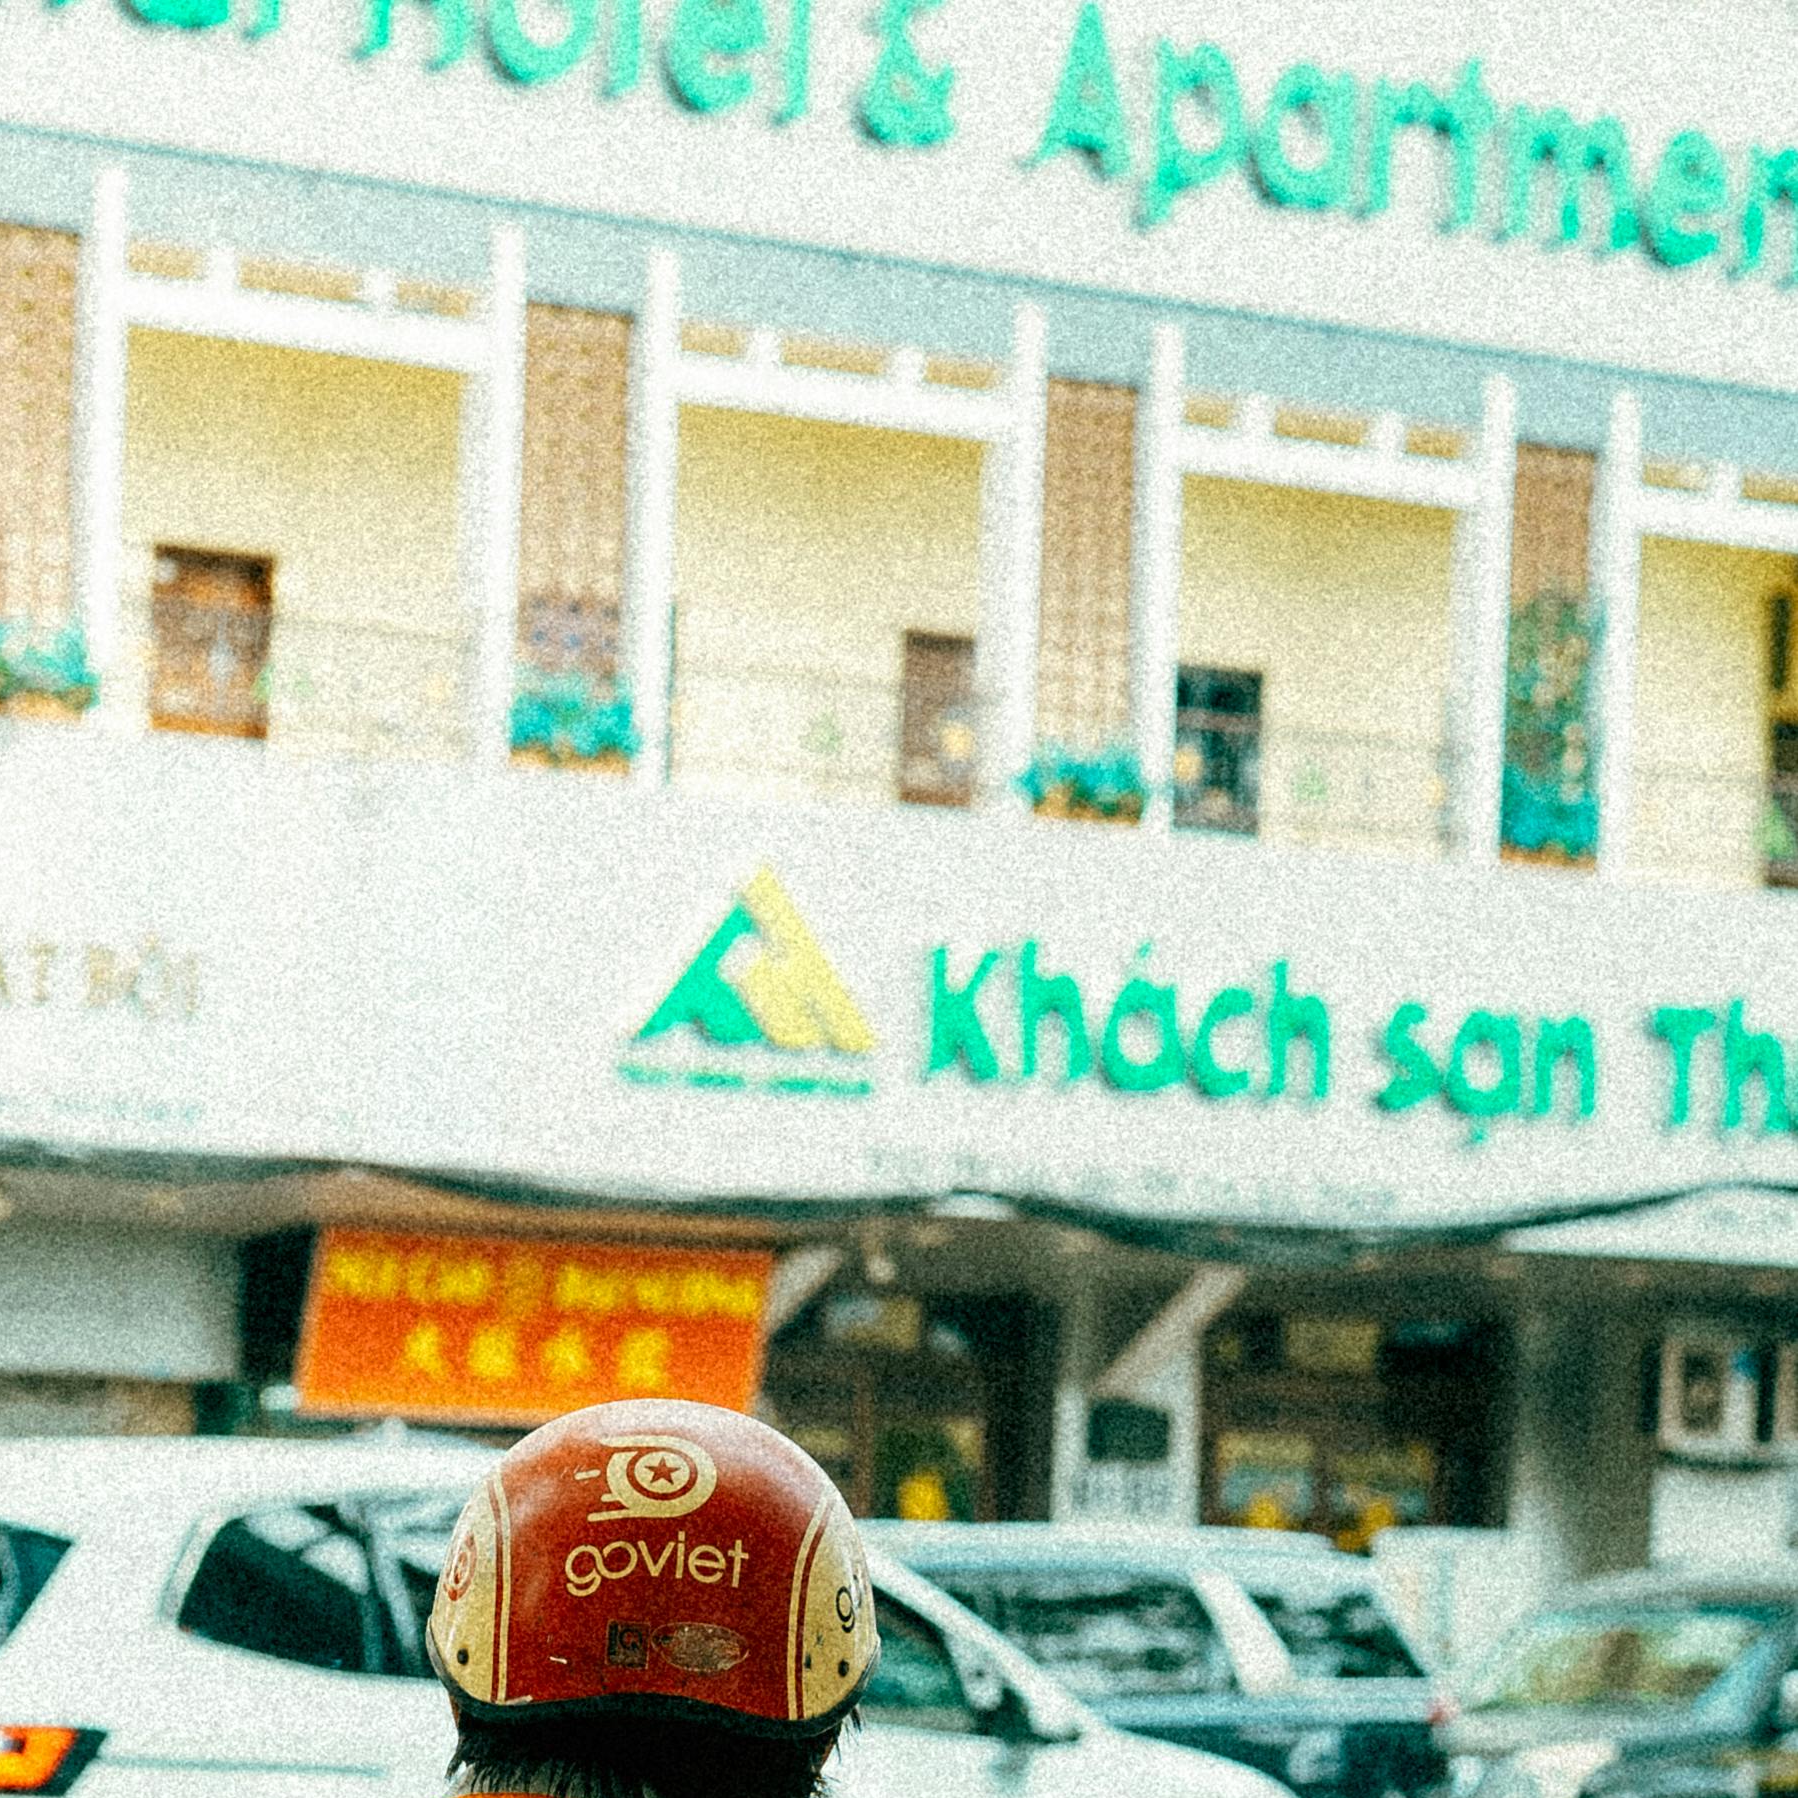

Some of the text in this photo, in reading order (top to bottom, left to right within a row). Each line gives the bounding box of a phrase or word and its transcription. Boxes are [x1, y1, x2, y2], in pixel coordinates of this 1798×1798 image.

[856, 0, 959, 151] &
[920, 936, 1336, 1105] Khách
[1371, 998, 1602, 1148] sạn
[564, 1530, 750, 1597] goviet
